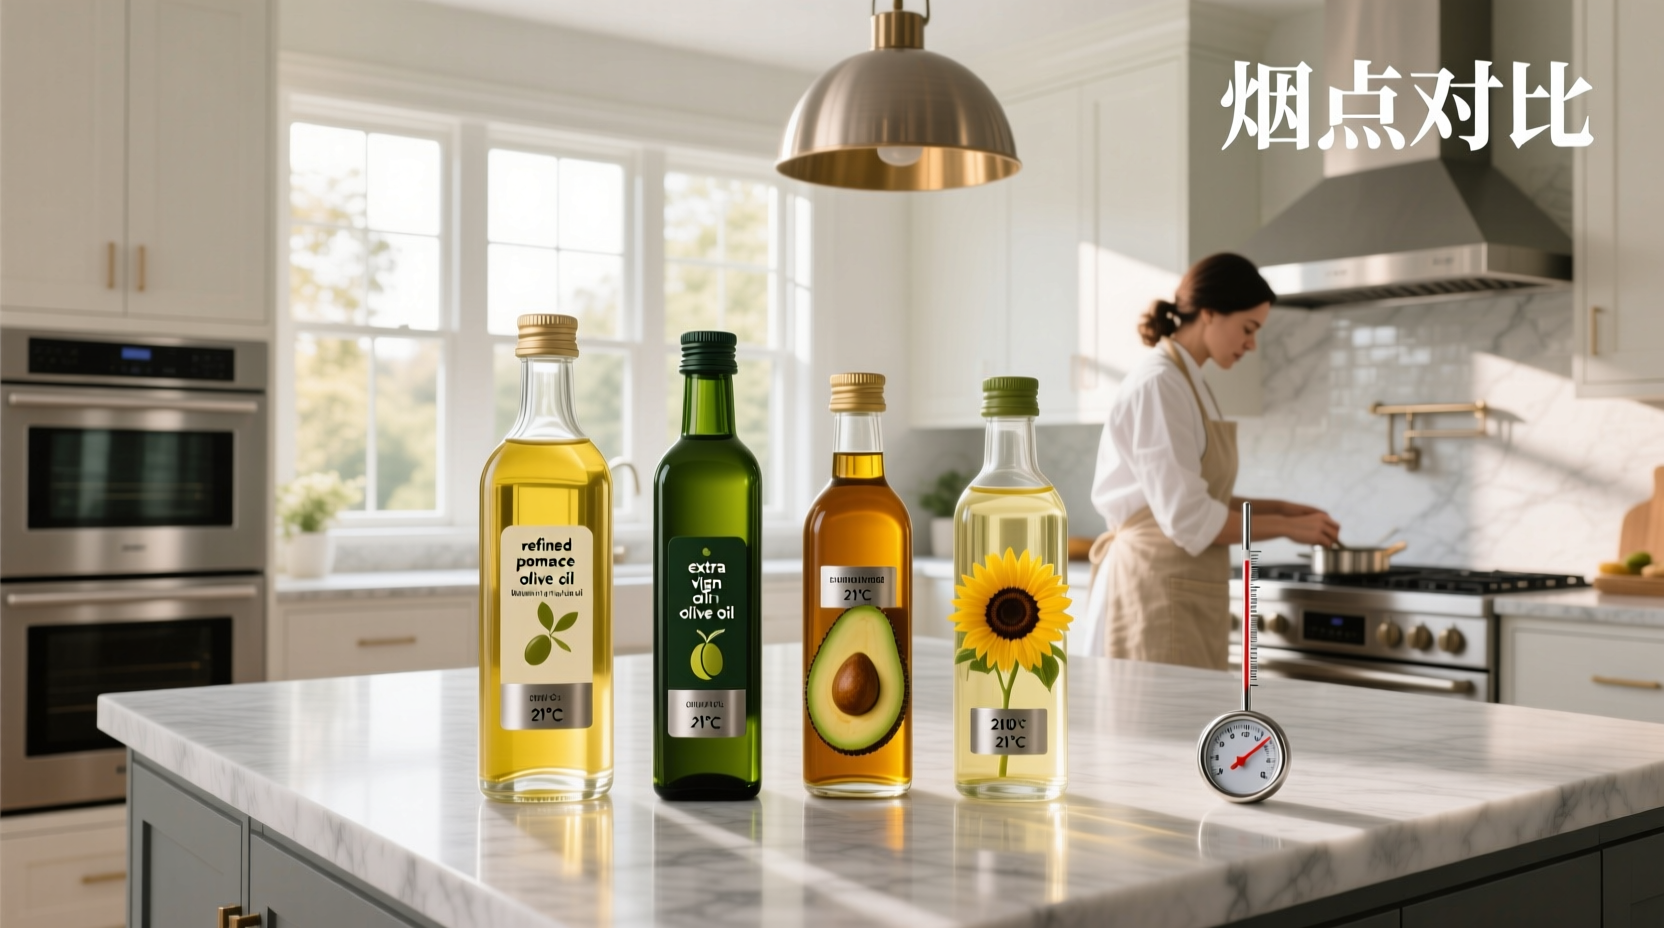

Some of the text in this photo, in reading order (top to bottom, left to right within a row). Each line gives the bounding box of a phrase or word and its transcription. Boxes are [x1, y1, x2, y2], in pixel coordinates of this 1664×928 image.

[521, 537, 572, 551] refined
[516, 557, 575, 572] pomace
[688, 561, 726, 574] extra
[519, 571, 574, 585] olive oil
[679, 606, 734, 620] olive oil
[531, 707, 563, 722] 21°C
[995, 735, 1026, 748] 21°C
